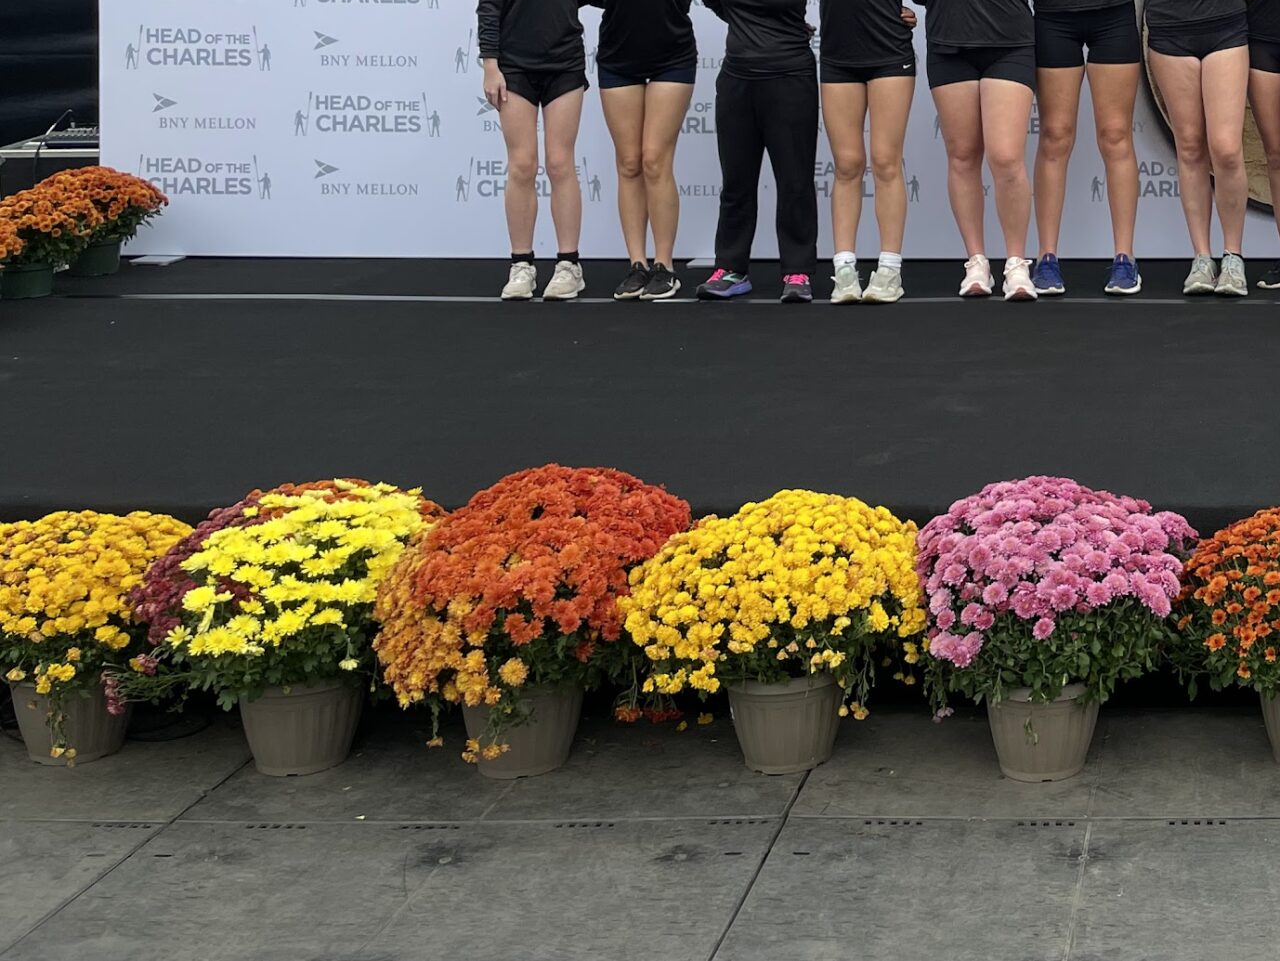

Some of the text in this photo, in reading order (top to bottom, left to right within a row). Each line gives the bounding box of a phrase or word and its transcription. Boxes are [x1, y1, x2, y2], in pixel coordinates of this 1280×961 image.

[146, 28, 251, 45] HEAD OF THE
[146, 48, 252, 67] CHARLES
[320, 55, 417, 67] BNY MELLON
[315, 95, 420, 111] HEAD OF THE
[694, 102, 713, 113] OF
[159, 117, 256, 129] BNY MELLON
[315, 114, 421, 133] CHARLES
[146, 157, 251, 174] HEAD OF THE
[321, 183, 418, 195] BNY MELLON
[679, 184, 721, 197] MELL
